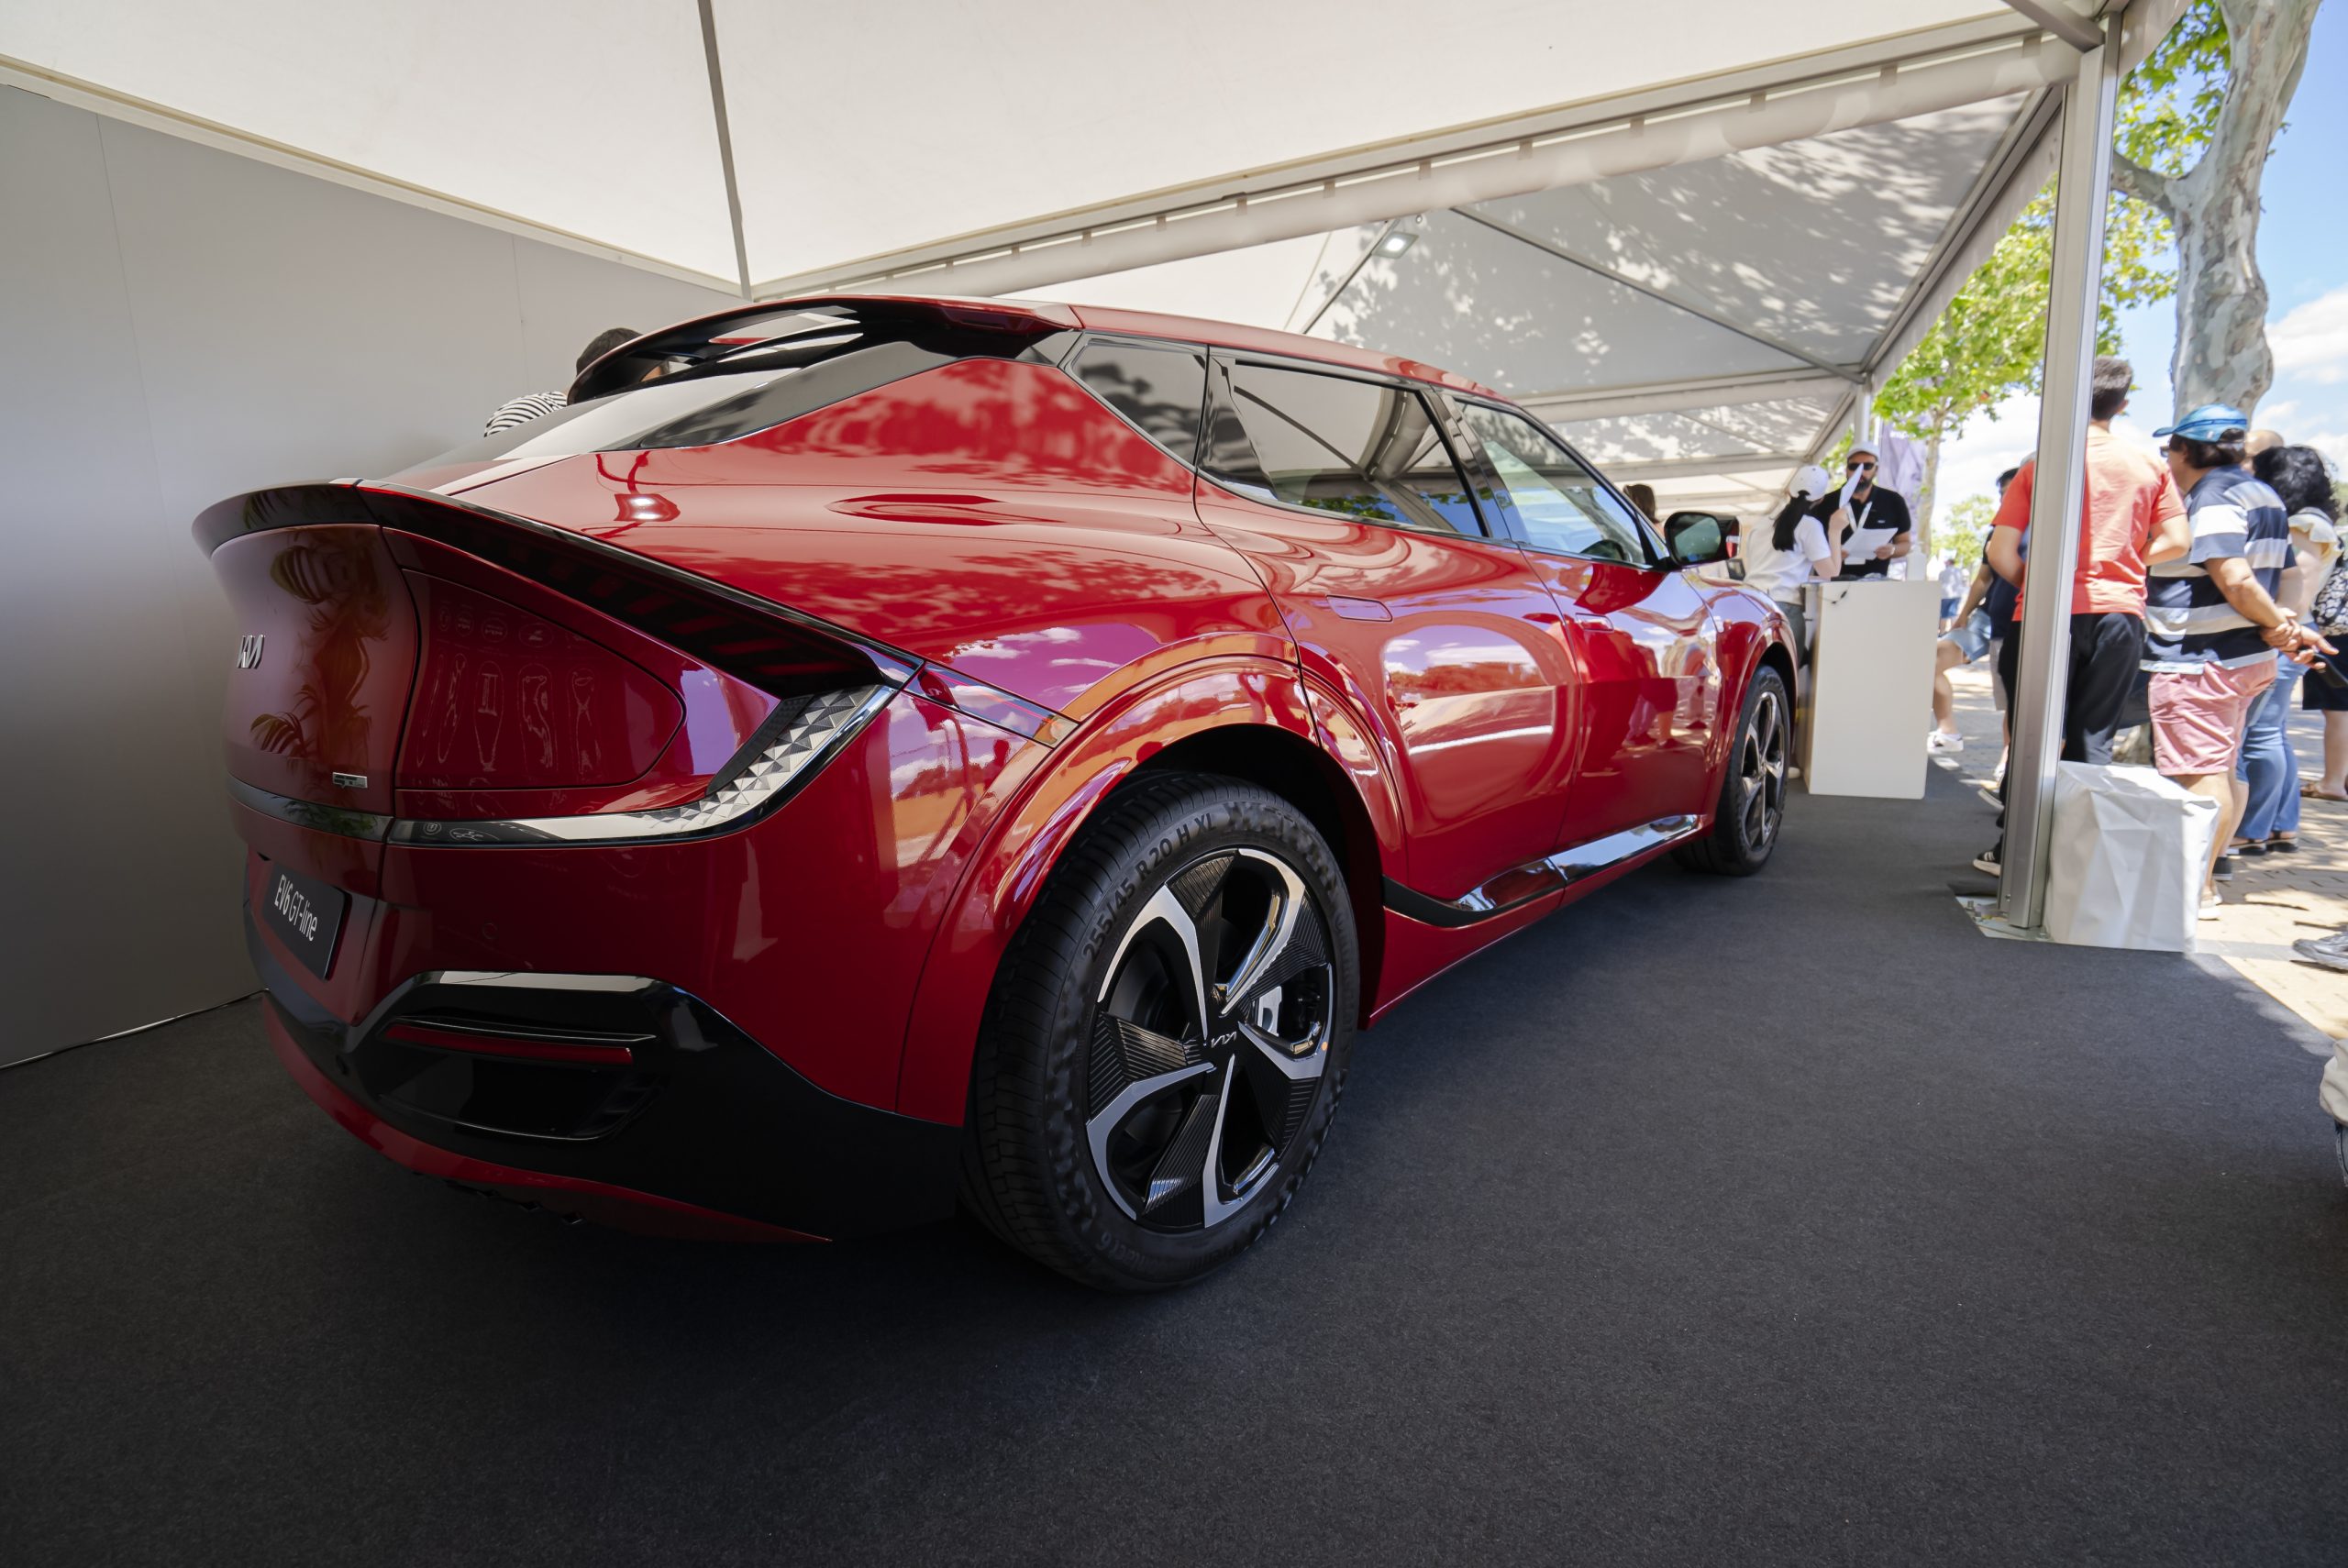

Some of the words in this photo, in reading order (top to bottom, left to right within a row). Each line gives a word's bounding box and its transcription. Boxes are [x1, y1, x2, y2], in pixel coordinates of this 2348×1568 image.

[274, 874, 294, 916] EV6
[288, 890, 317, 942] GT-line
[1082, 877, 1136, 963] 255/45
[1135, 859, 1152, 882] R
[1148, 837, 1173, 868] 20
[1176, 823, 1191, 847] H
[1193, 812, 1216, 835] XL
